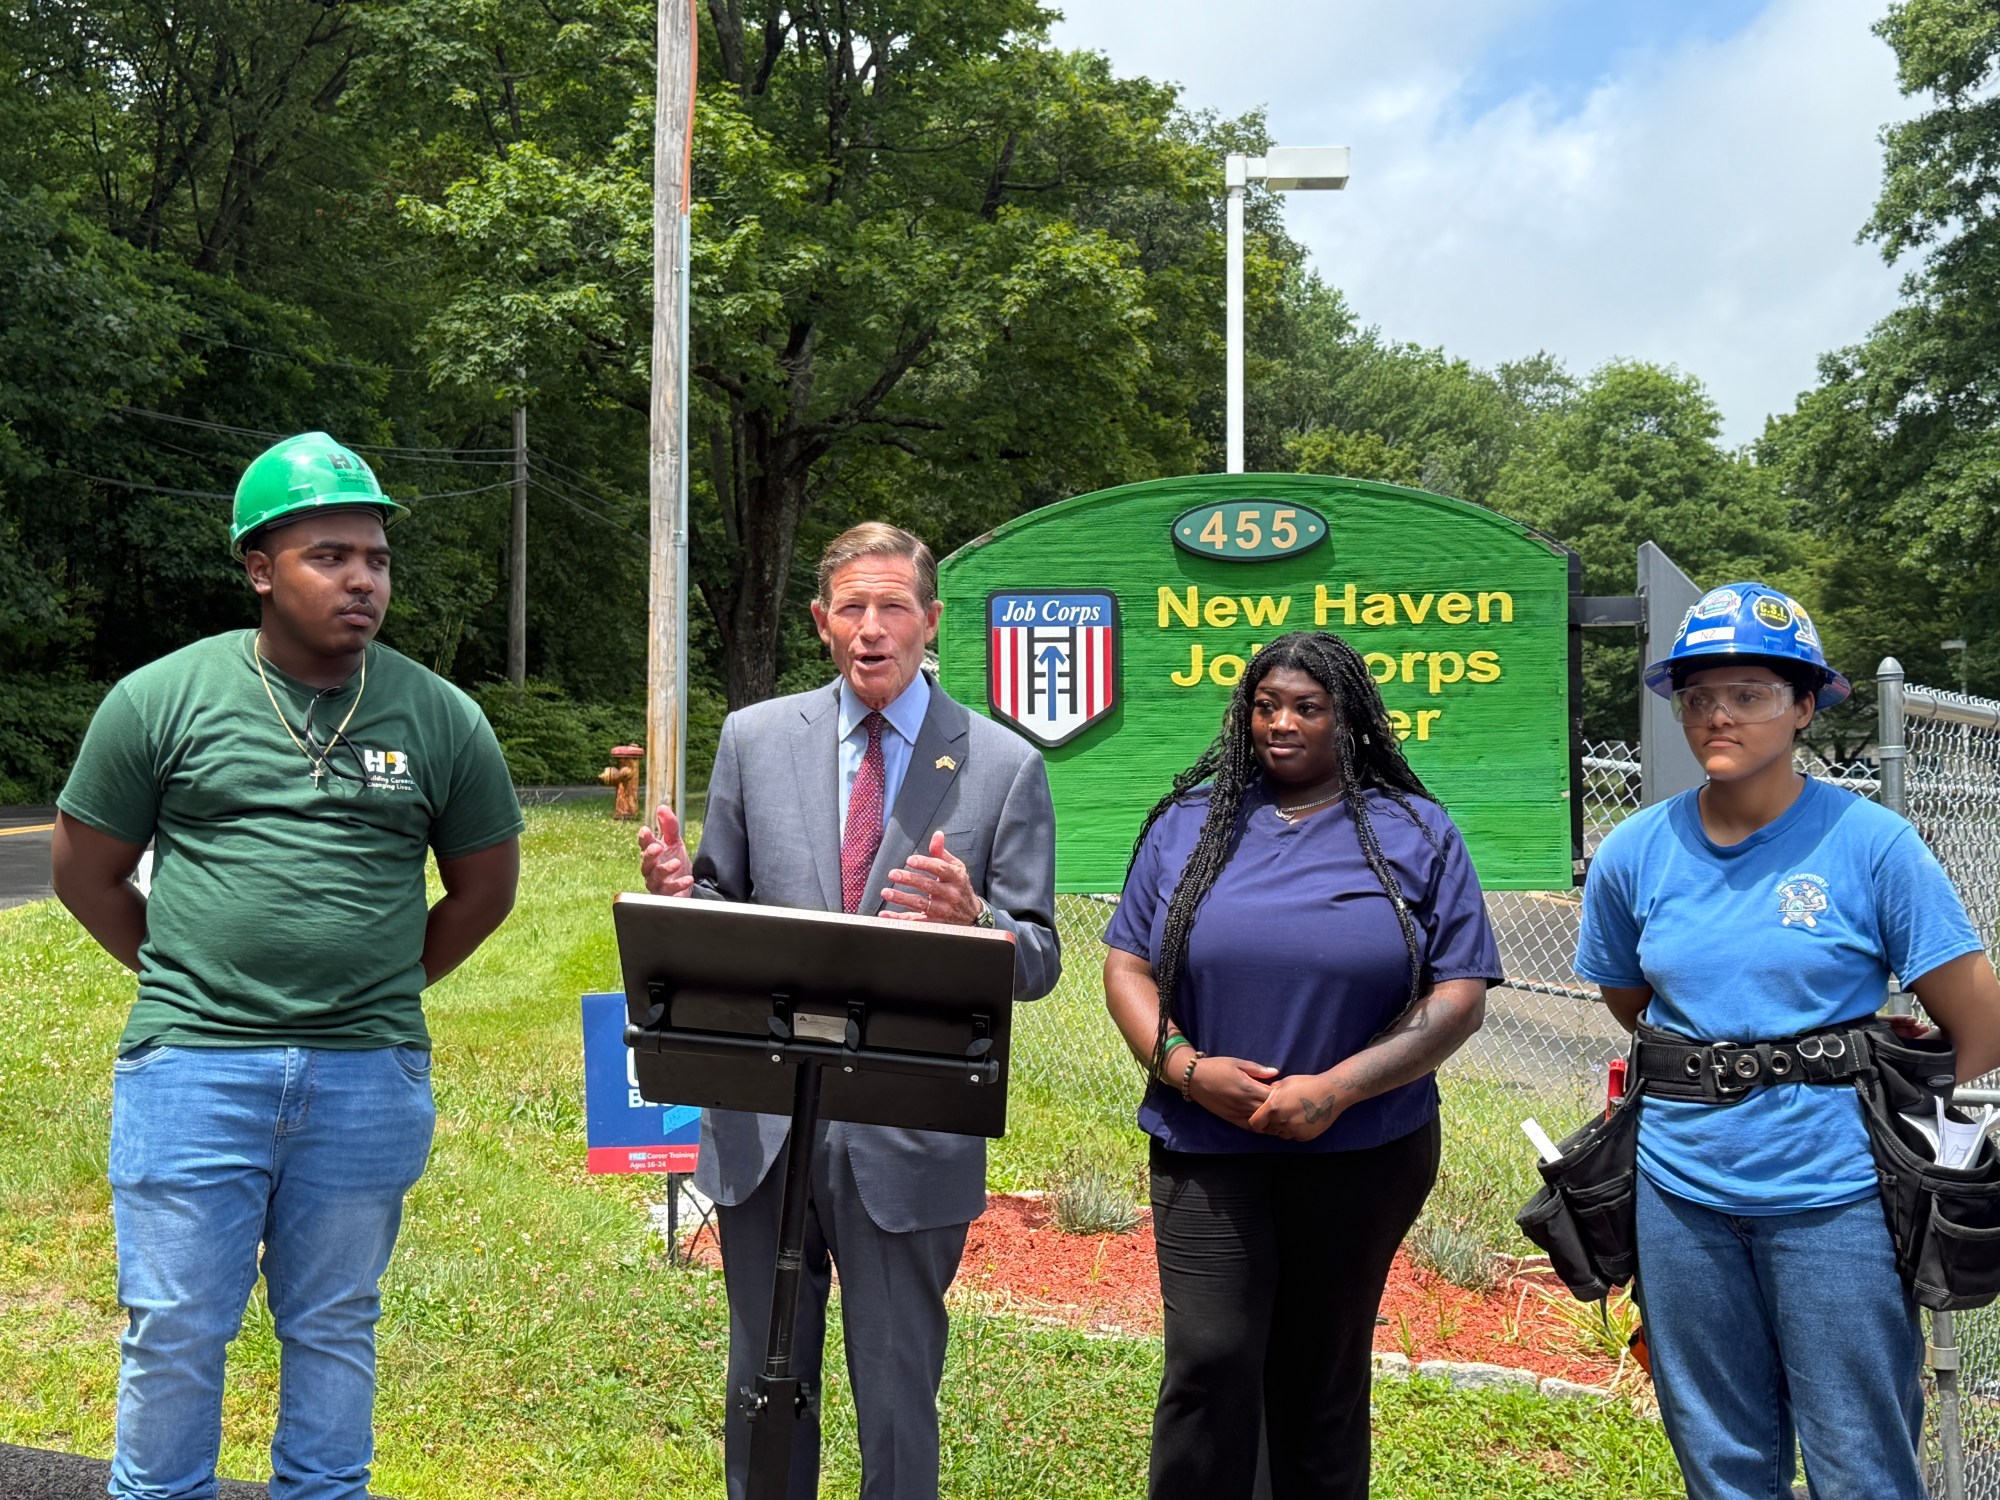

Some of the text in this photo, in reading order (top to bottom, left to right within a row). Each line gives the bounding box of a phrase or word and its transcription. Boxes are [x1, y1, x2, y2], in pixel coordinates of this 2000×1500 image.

[1199, 510, 1299, 550] 455
[1002, 600, 1101, 625] Job Corps
[1158, 583, 1514, 628] New Haven
[1170, 644, 1502, 694] Jo orps
[629, 1162, 646, 1170] Ages
[647, 1152, 668, 1160] Career
[669, 1151, 695, 1160] Training
